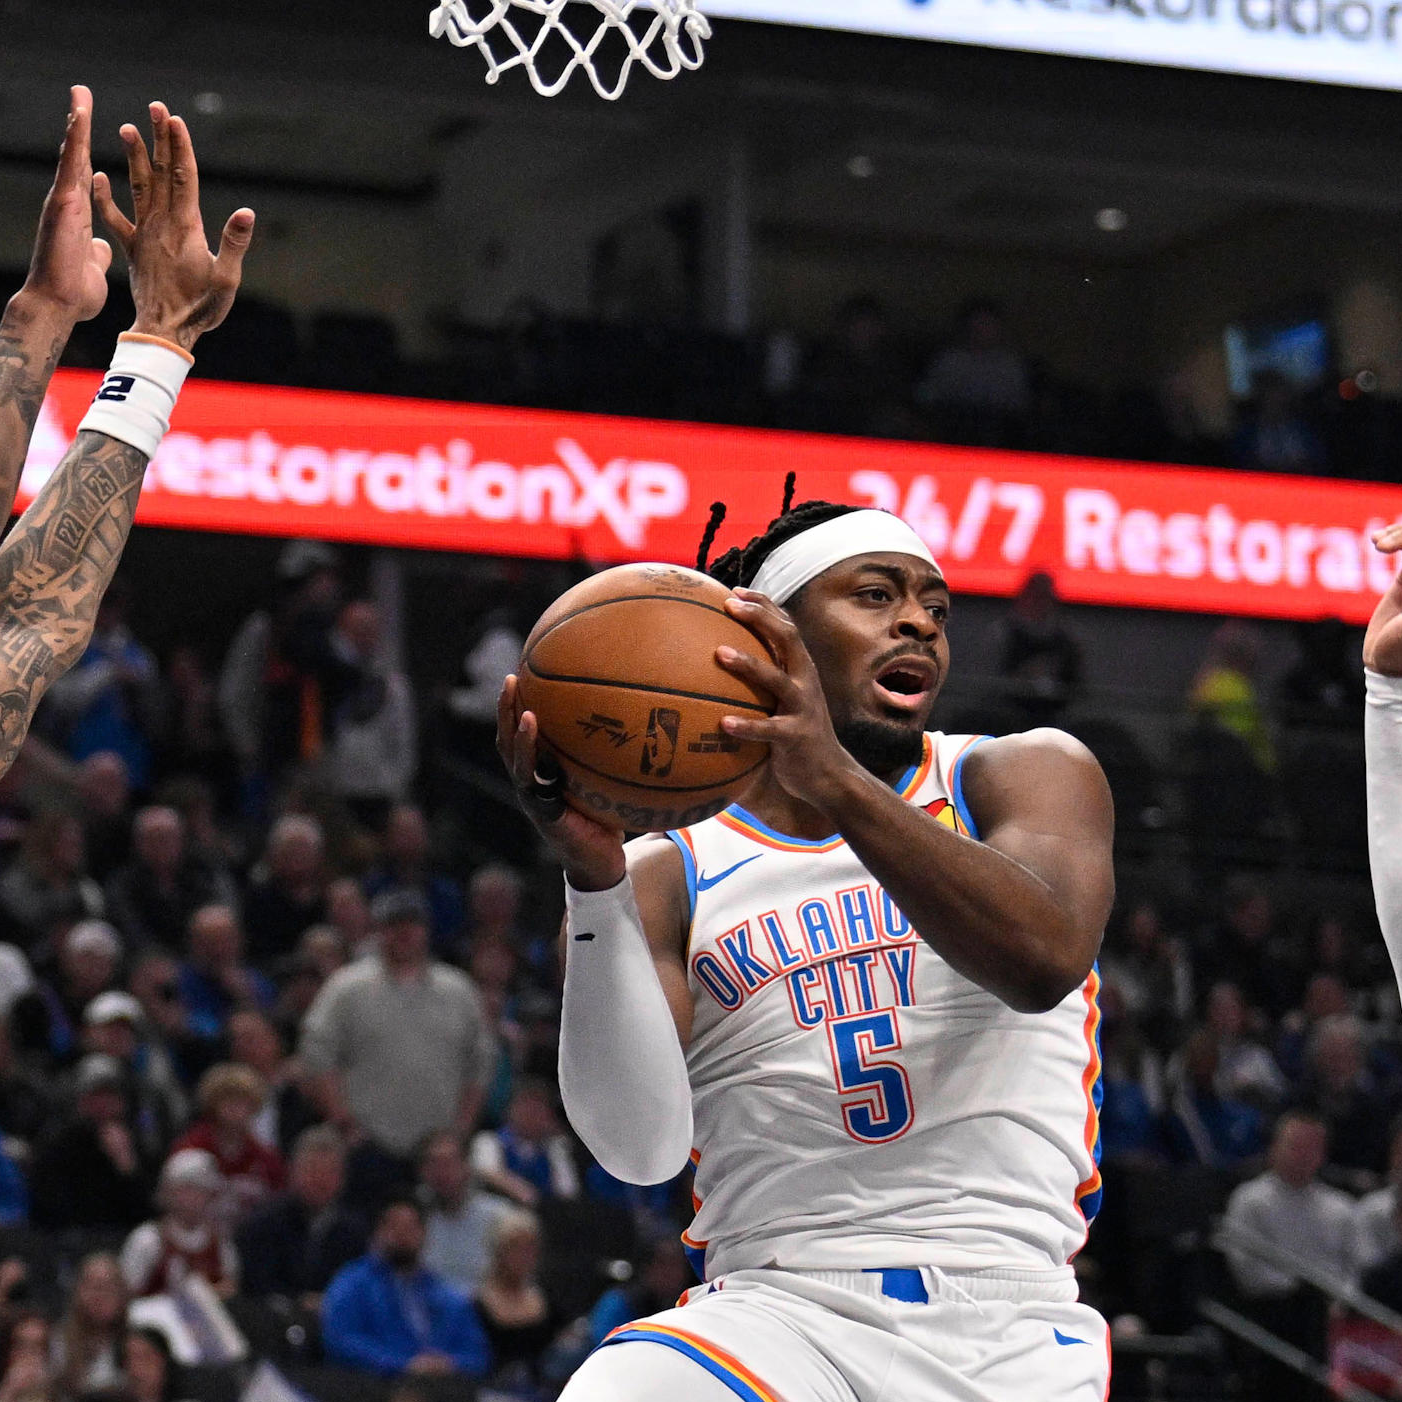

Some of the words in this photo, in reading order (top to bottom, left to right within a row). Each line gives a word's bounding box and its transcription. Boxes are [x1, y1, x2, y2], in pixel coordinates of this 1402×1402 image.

[145, 430, 688, 548] estorationXP
[692, 884, 916, 1011] OKLAHO
[785, 943, 917, 1030] CITY
[826, 1006, 915, 1144] 5
